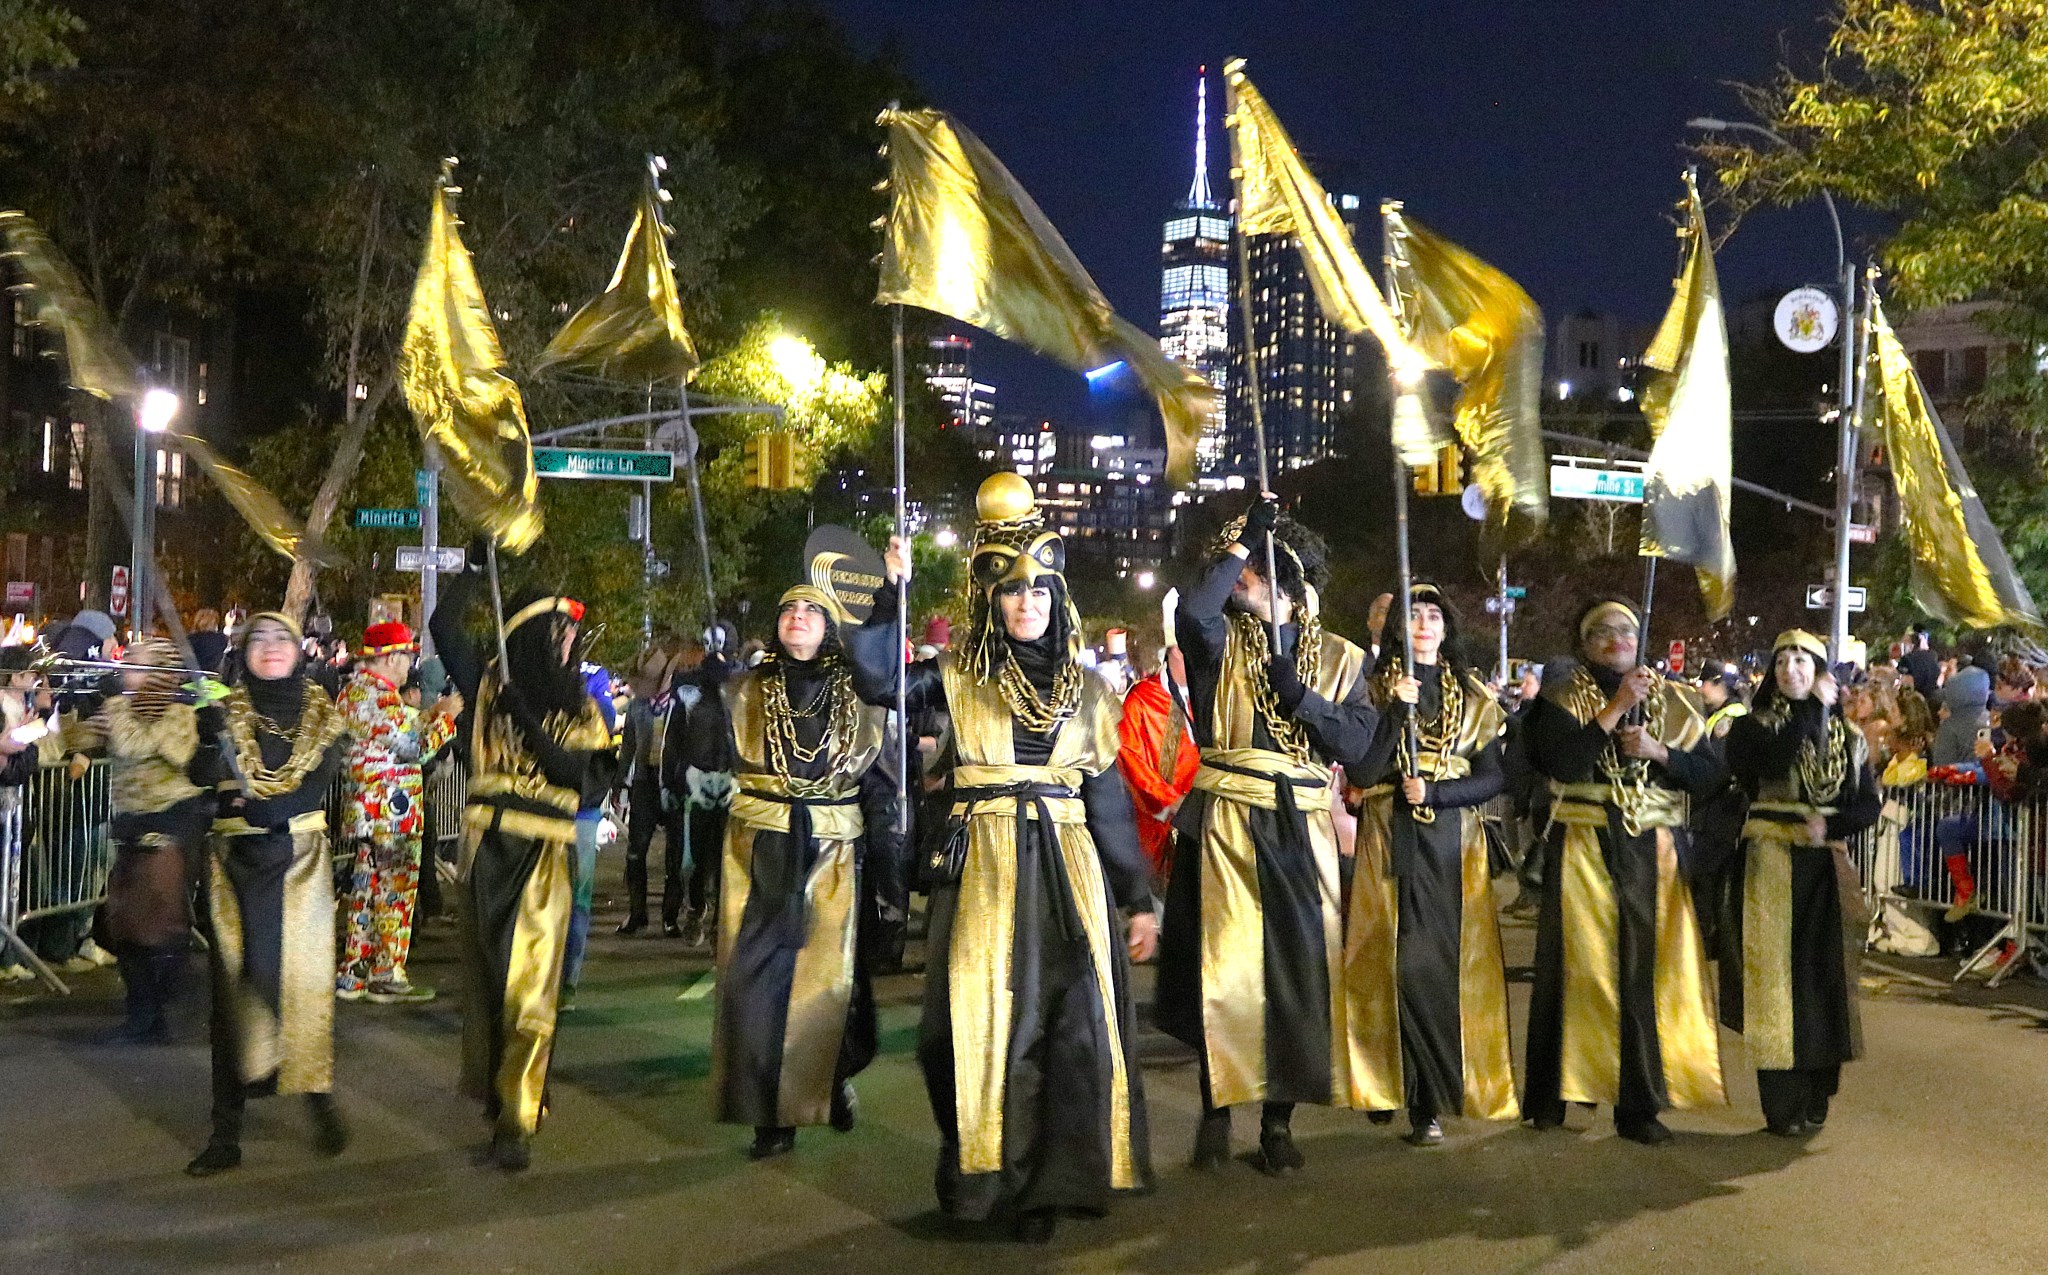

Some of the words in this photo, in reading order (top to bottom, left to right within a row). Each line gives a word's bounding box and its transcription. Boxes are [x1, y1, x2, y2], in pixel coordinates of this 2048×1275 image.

[567, 454, 613, 471] Minetta
[619, 457, 634, 473] Ln
[1624, 479, 1635, 495] St
[360, 511, 405, 524] Minetta
